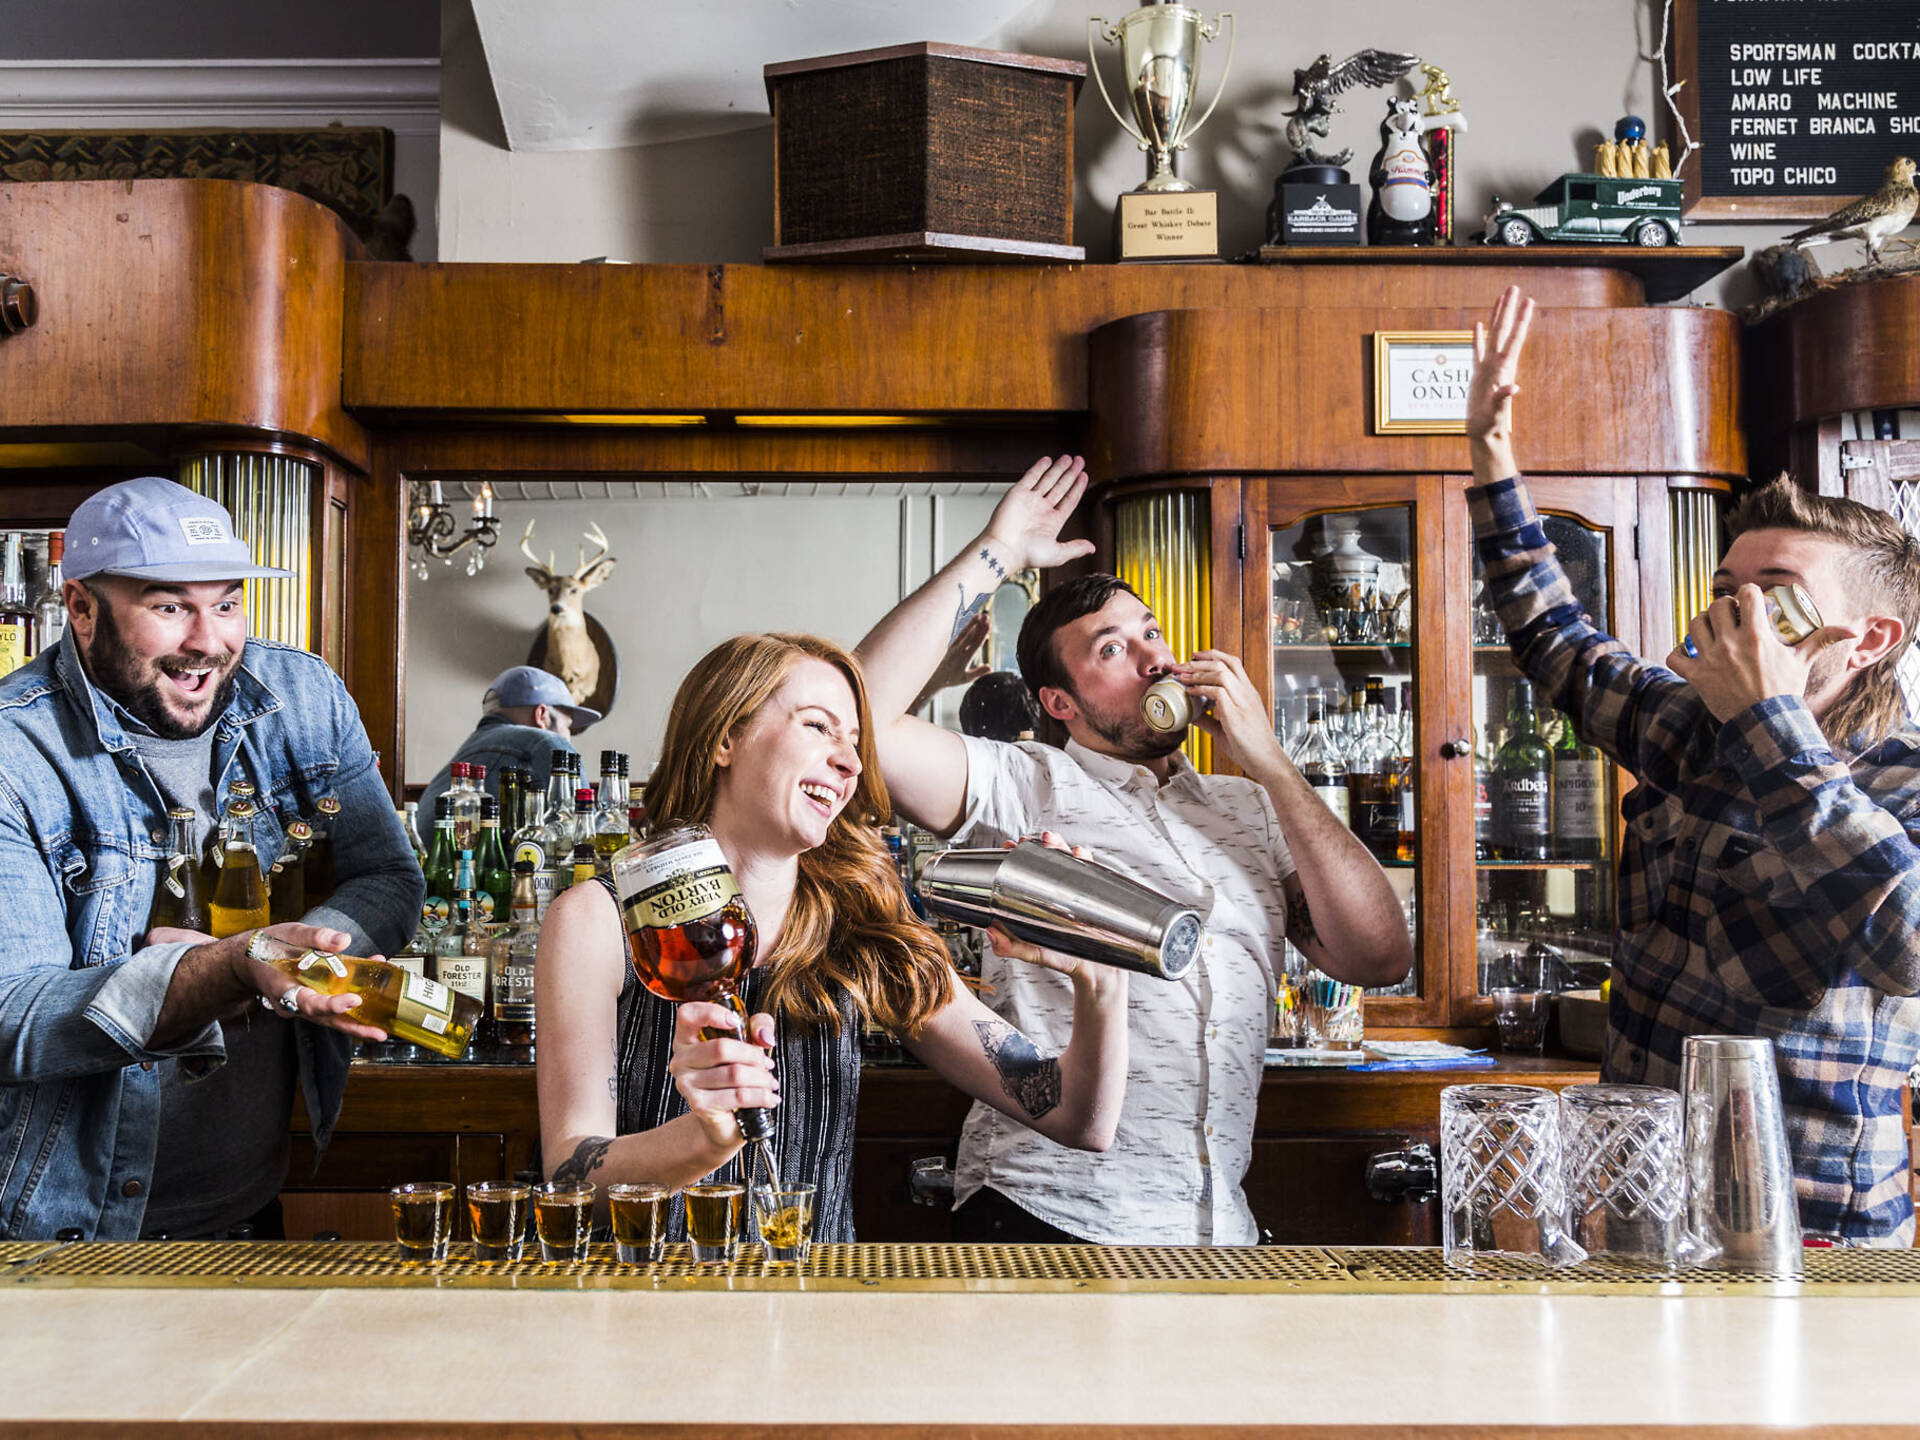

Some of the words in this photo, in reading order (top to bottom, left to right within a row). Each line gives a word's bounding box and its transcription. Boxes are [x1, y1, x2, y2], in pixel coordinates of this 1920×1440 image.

[1730, 43, 1836, 61] SPORTSMAN
[1853, 42, 1920, 60] COCKTA
[1731, 68, 1771, 86] LOW
[1783, 68, 1822, 85] LIFE
[1731, 93, 1791, 111] AMARO
[1818, 92, 1898, 110] MACHINE
[1730, 118, 1798, 135] FERNET
[1810, 117, 1876, 135] BRANCA
[1730, 143, 1776, 160] WINE
[1730, 168, 1774, 185] TOPO
[1784, 167, 1836, 184] CHICO
[1617, 185, 1661, 205] Underberg
[1152, 221, 1183, 229] Whiskey
[1411, 369, 1469, 383] CASH
[1413, 386, 1469, 399] ONLY
[648, 879, 722, 913] BARTON
[690, 892, 721, 908] VERY
[658, 903, 686, 919] OLD
[442, 971, 481, 980] FORESTER
[504, 966, 527, 976] OLD
